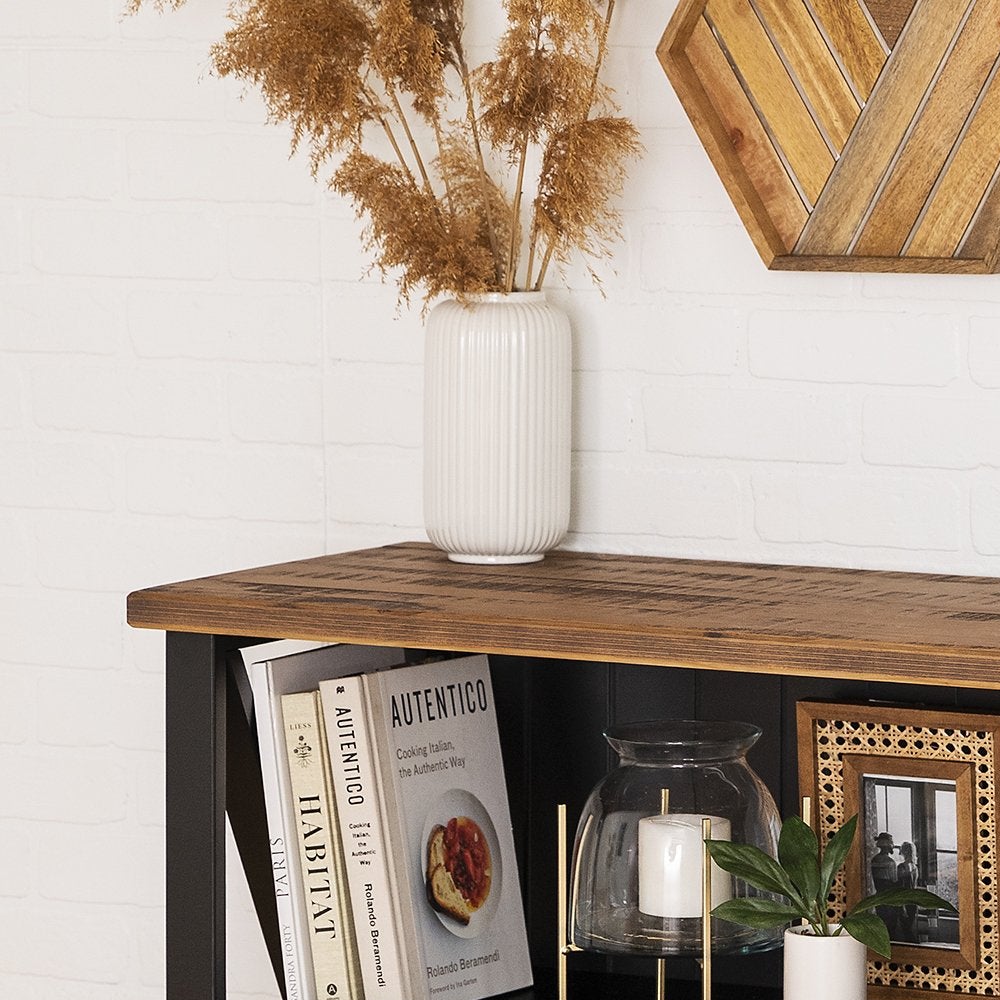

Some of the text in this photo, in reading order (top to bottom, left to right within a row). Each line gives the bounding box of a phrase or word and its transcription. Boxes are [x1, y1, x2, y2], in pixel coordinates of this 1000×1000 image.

[391, 678, 488, 728] AUTENTICO
[289, 723, 312, 731] LIESS
[335, 707, 364, 805] AUTENTICO
[396, 740, 455, 760] Cooking Italian,
[398, 755, 466, 778] the Authentic Way
[270, 837, 289, 897] PARIS
[298, 795, 336, 939] HABITAT
[282, 924, 293, 957] FORTY
[364, 883, 386, 987] Rolando Beramendi
[426, 949, 500, 979] Rolando Beramendi
